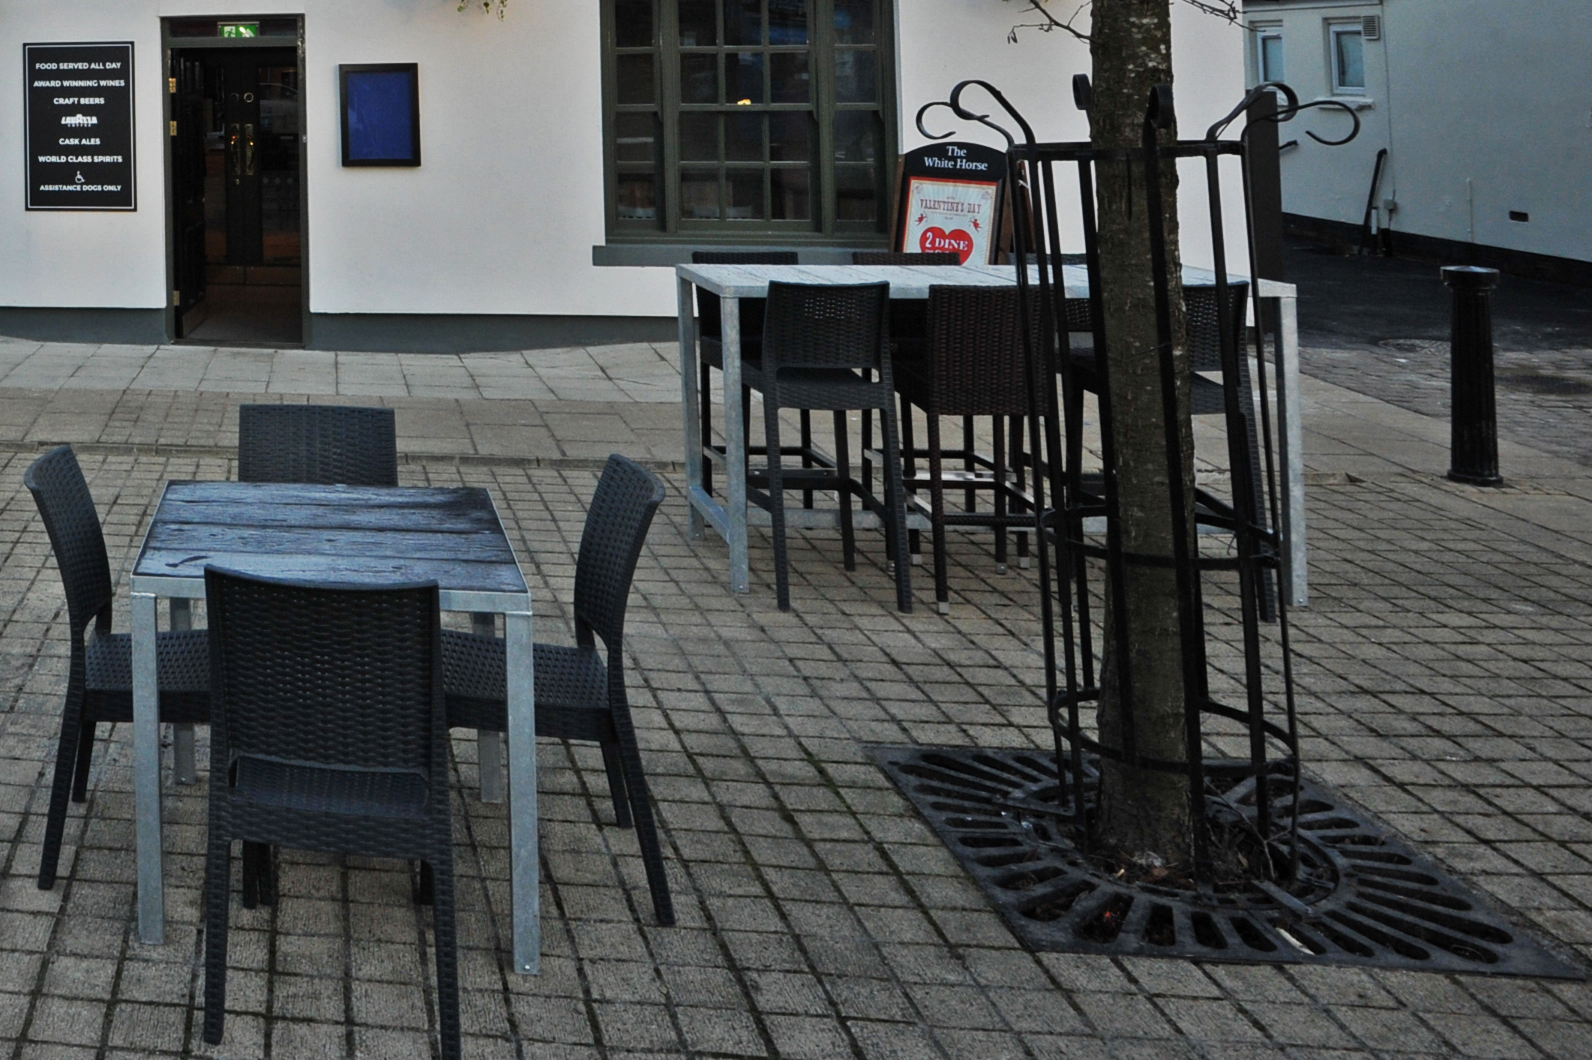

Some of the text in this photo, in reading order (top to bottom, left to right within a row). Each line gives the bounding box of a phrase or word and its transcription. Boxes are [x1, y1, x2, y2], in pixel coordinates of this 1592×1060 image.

[35, 62, 57, 70] FOOD
[59, 62, 89, 70] SERVED
[99, 79, 125, 87] WINES
[53, 97, 105, 105] CRAFT BEERS
[946, 145, 967, 157] The
[38, 155, 123, 163] WORLD CLASS SPIRITS
[924, 156, 988, 170] White Horse
[919, 198, 965, 213] VALENTINE'S
[967, 202, 982, 215] DAY
[925, 231, 968, 251] 2 DINE
